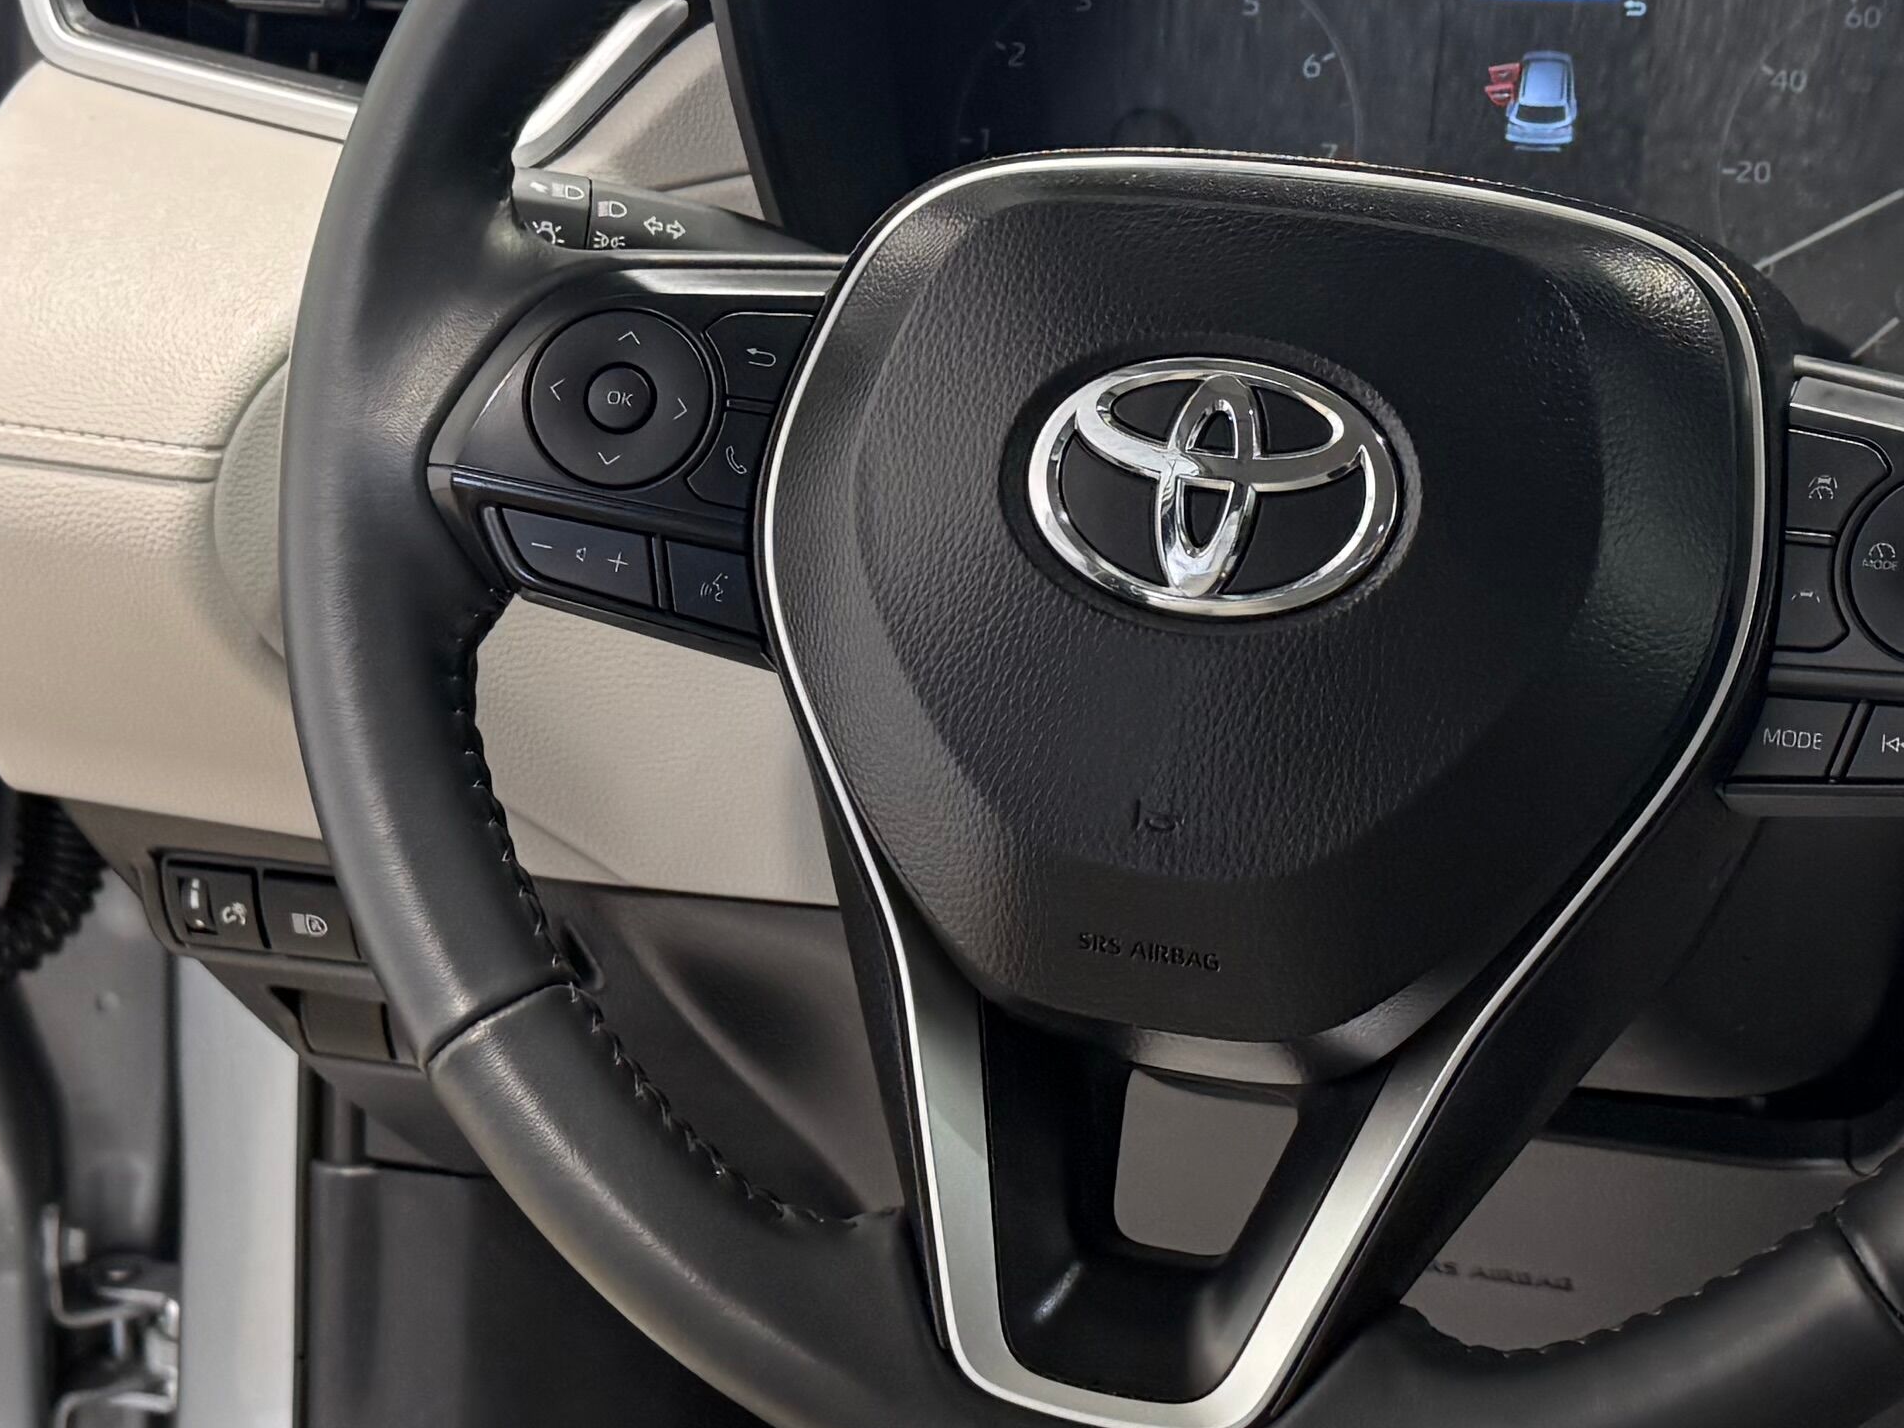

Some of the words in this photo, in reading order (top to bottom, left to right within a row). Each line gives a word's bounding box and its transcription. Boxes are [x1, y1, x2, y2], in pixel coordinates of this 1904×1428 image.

[1846, 6, 1882, 29] 60
[1006, 42, 1026, 68] 2
[1302, 54, 1322, 79] 6
[1770, 70, 1808, 92] 40
[1735, 161, 1772, 184] 20
[607, 390, 633, 408] OK
[1762, 727, 1824, 751] MODE
[1079, 932, 1121, 956] SRS
[1130, 939, 1221, 973] AIRBAG
